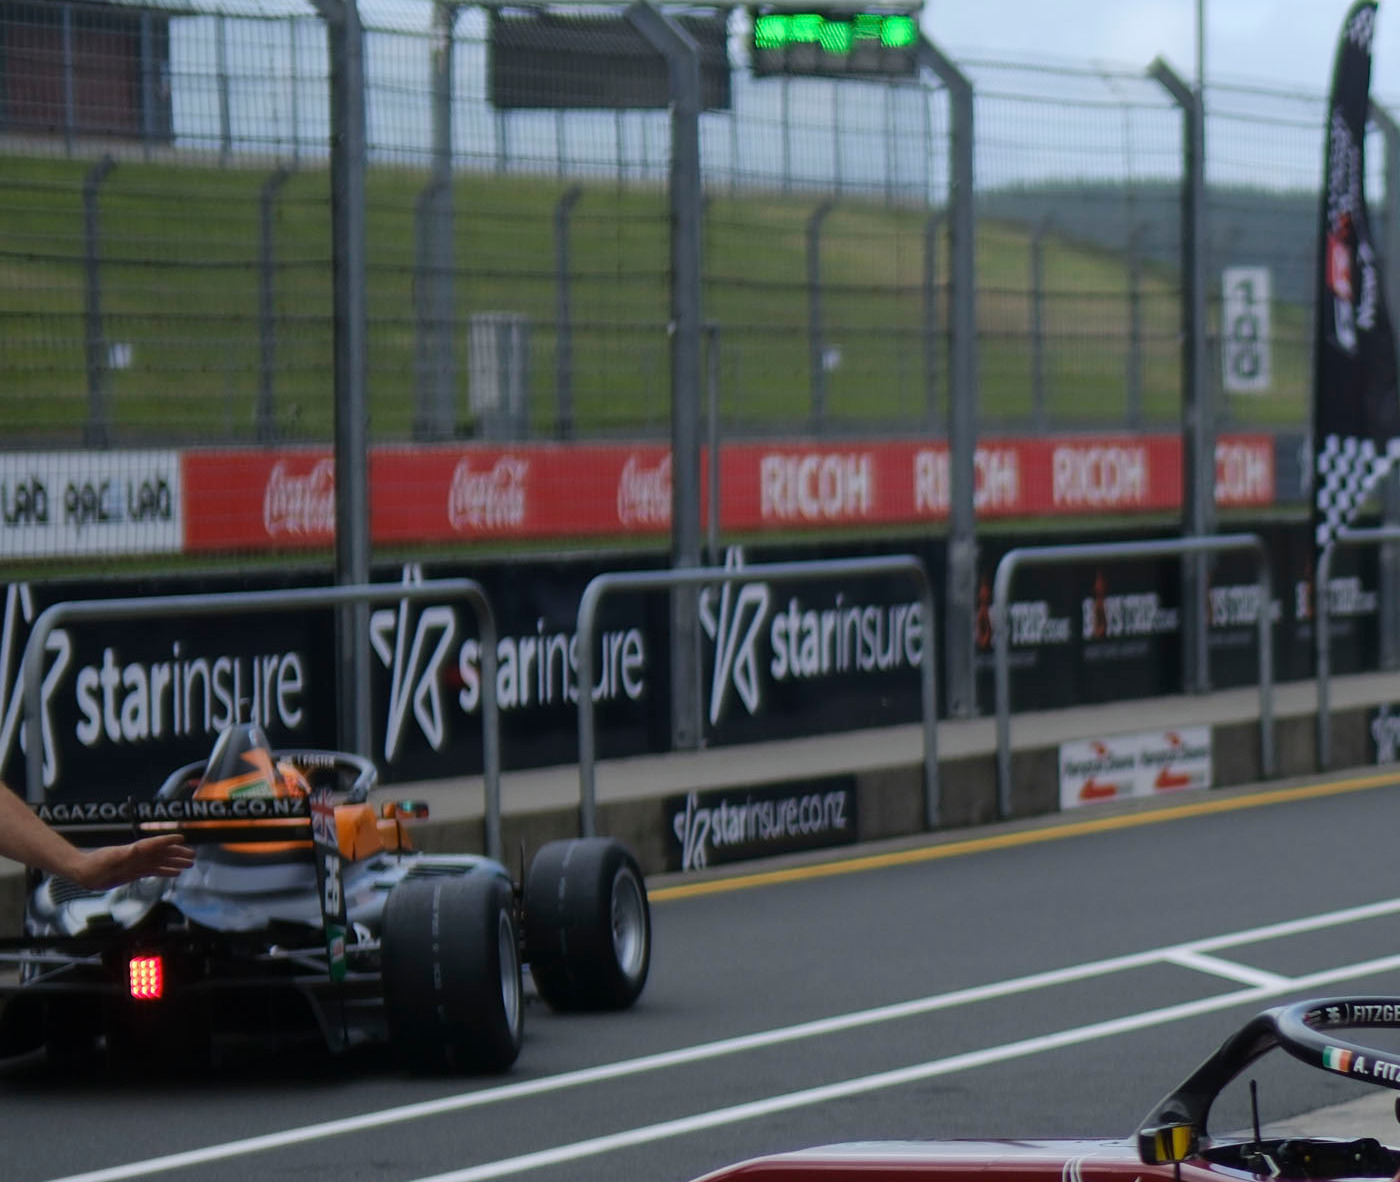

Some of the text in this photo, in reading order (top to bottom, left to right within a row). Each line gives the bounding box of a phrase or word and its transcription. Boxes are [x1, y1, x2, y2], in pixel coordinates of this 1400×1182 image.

[760, 454, 872, 518] RICOH
[914, 449, 1018, 513] RIOH
[1053, 447, 1149, 507] RICOH
[458, 617, 644, 712] sarinure
[771, 592, 924, 680] starinsure
[75, 641, 302, 746] starinsure
[1353, 1056, 1370, 1075] A.
